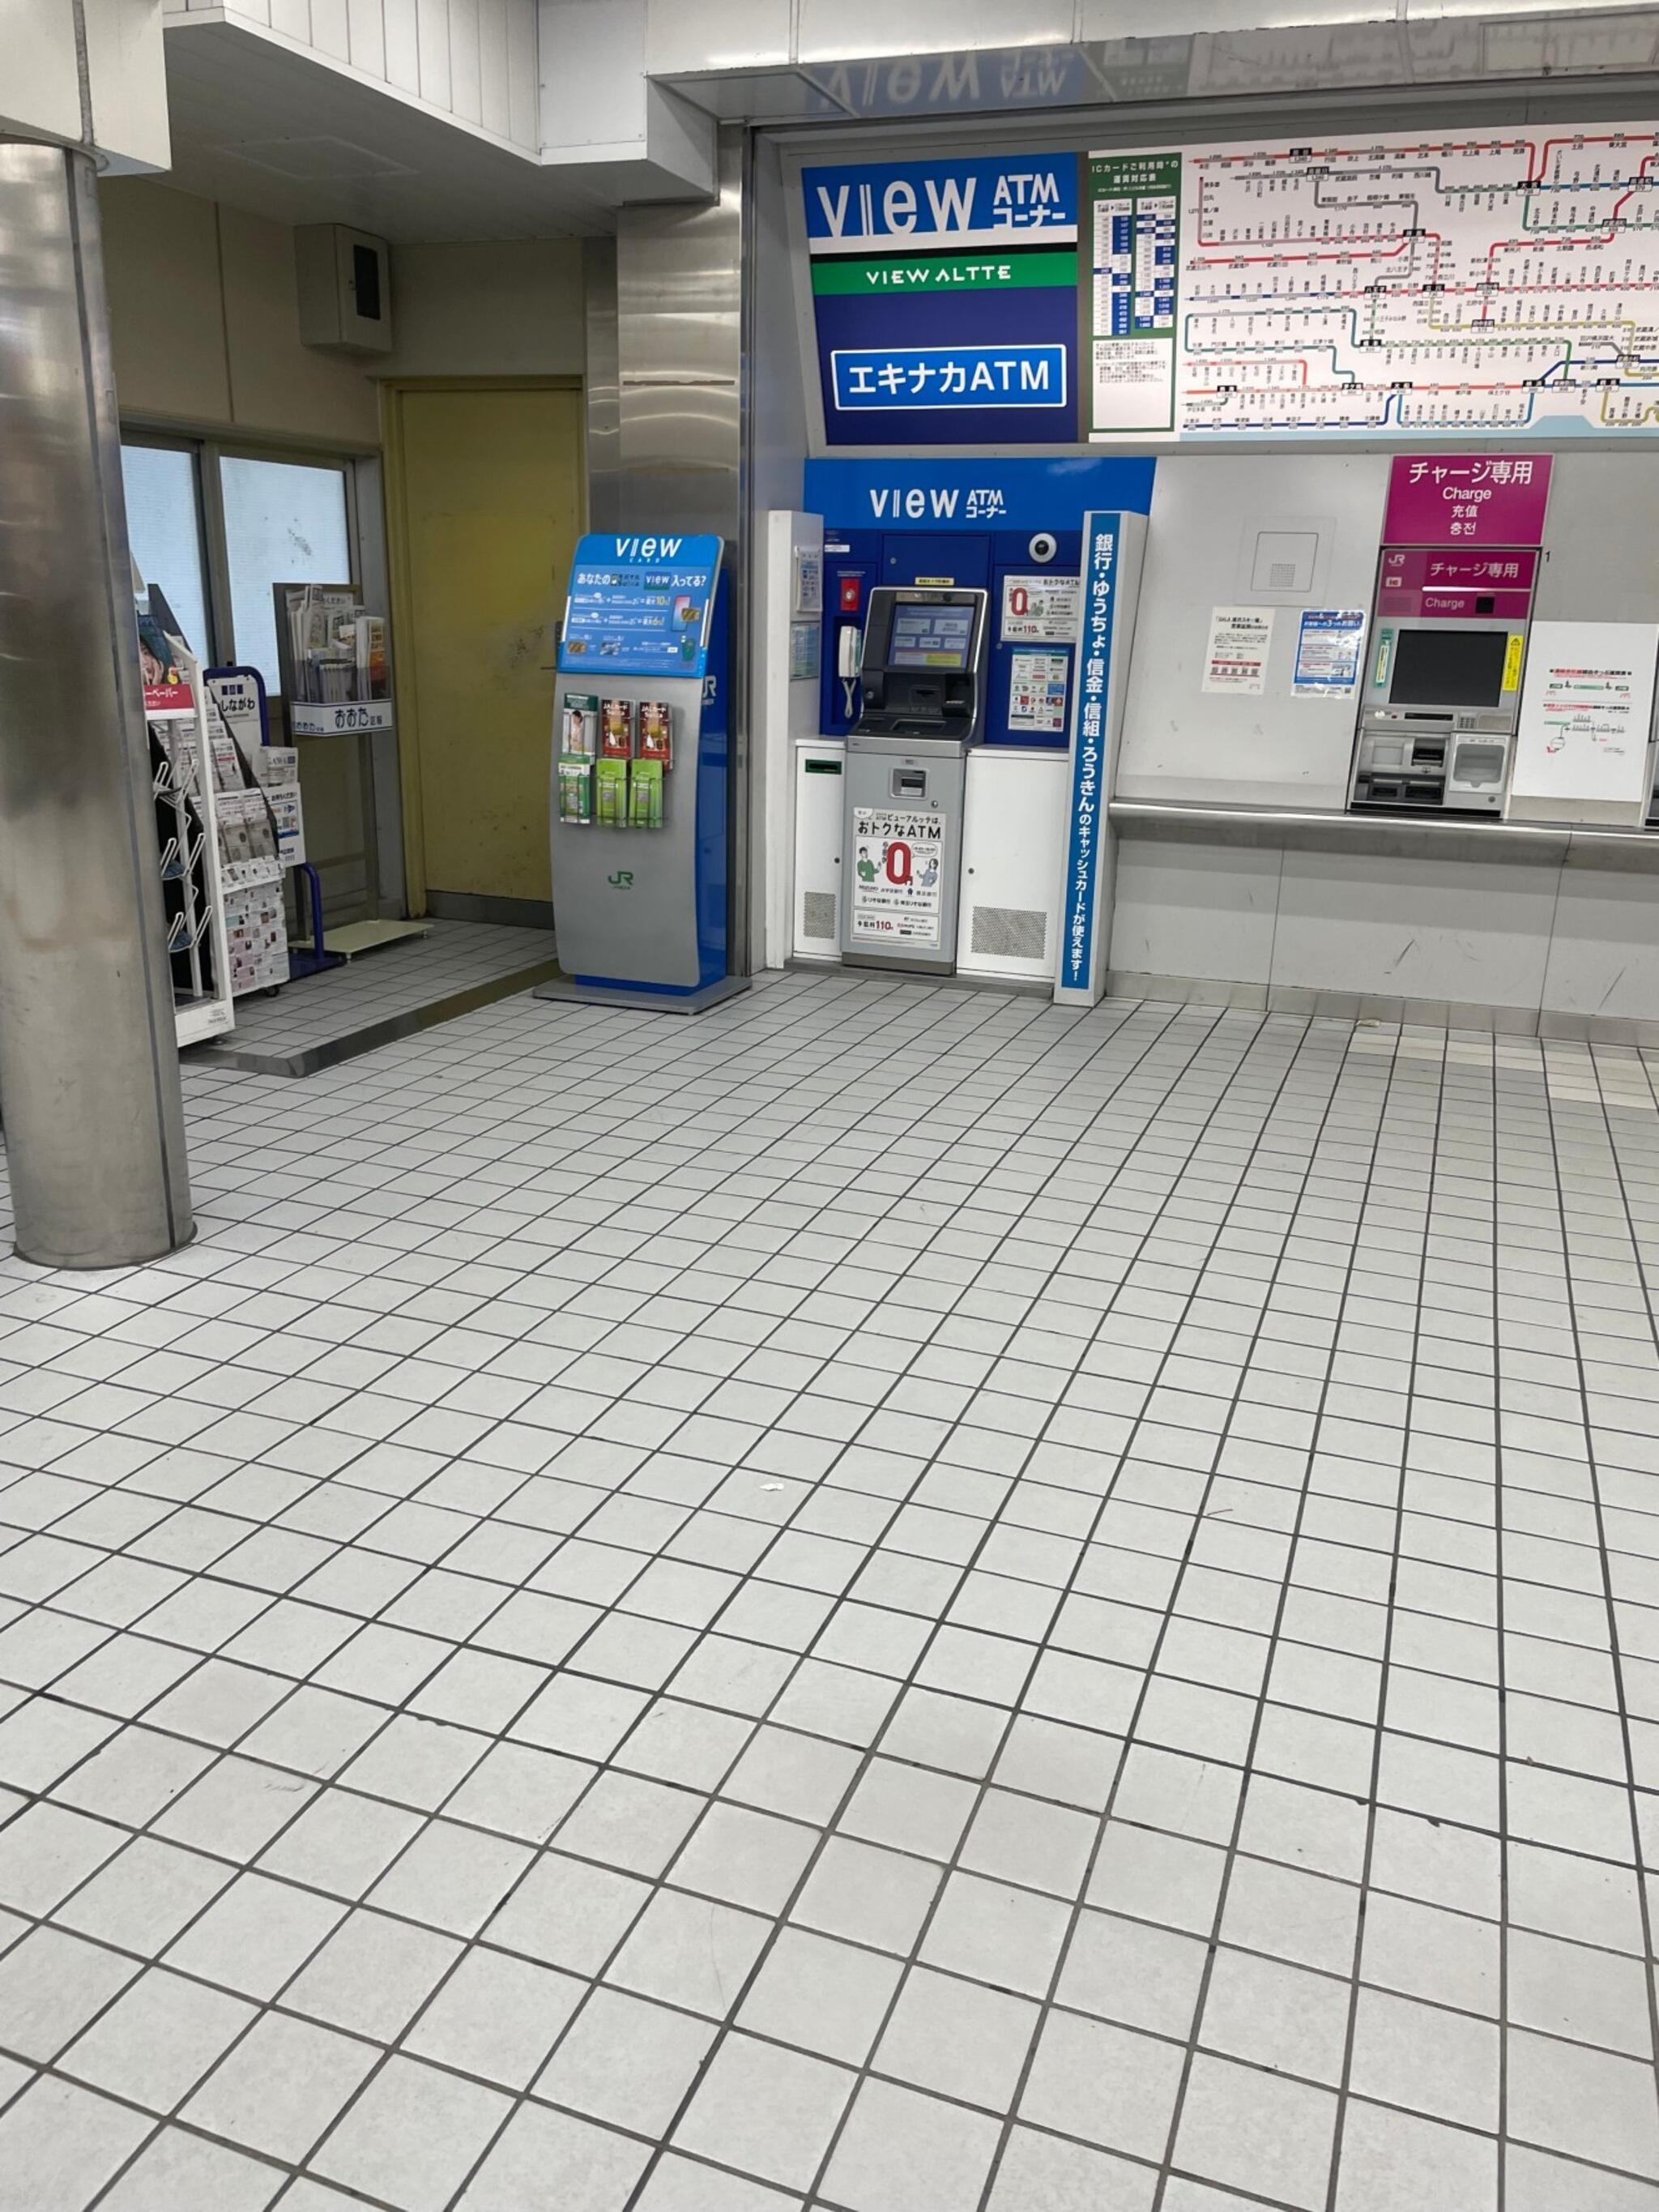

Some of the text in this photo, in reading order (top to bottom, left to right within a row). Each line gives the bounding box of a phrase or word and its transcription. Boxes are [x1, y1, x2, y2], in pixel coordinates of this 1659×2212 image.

[993, 173, 1060, 205] ATM
[992, 205, 1066, 229] コーナー
[867, 265, 1011, 285] VIEW ALTTE
[848, 360, 1050, 395] エキナカATM
[1409, 460, 1533, 485] チャージ専用
[966, 489, 1004, 506] ATM
[1442, 487, 1492, 502] Charge
[966, 506, 1007, 519] コーナー
[1451, 505, 1478, 519] 充值
[1449, 522, 1477, 536] 충전
[1388, 554, 1405, 565] JR
[1430, 562, 1520, 579] チャージ専用
[577, 572, 611, 585] あなたの
[672, 574, 707, 587] 入ってる?
[1425, 597, 1465, 610] Charge
[858, 822, 941, 839] おトクなATM
[608, 871, 634, 886] JR
